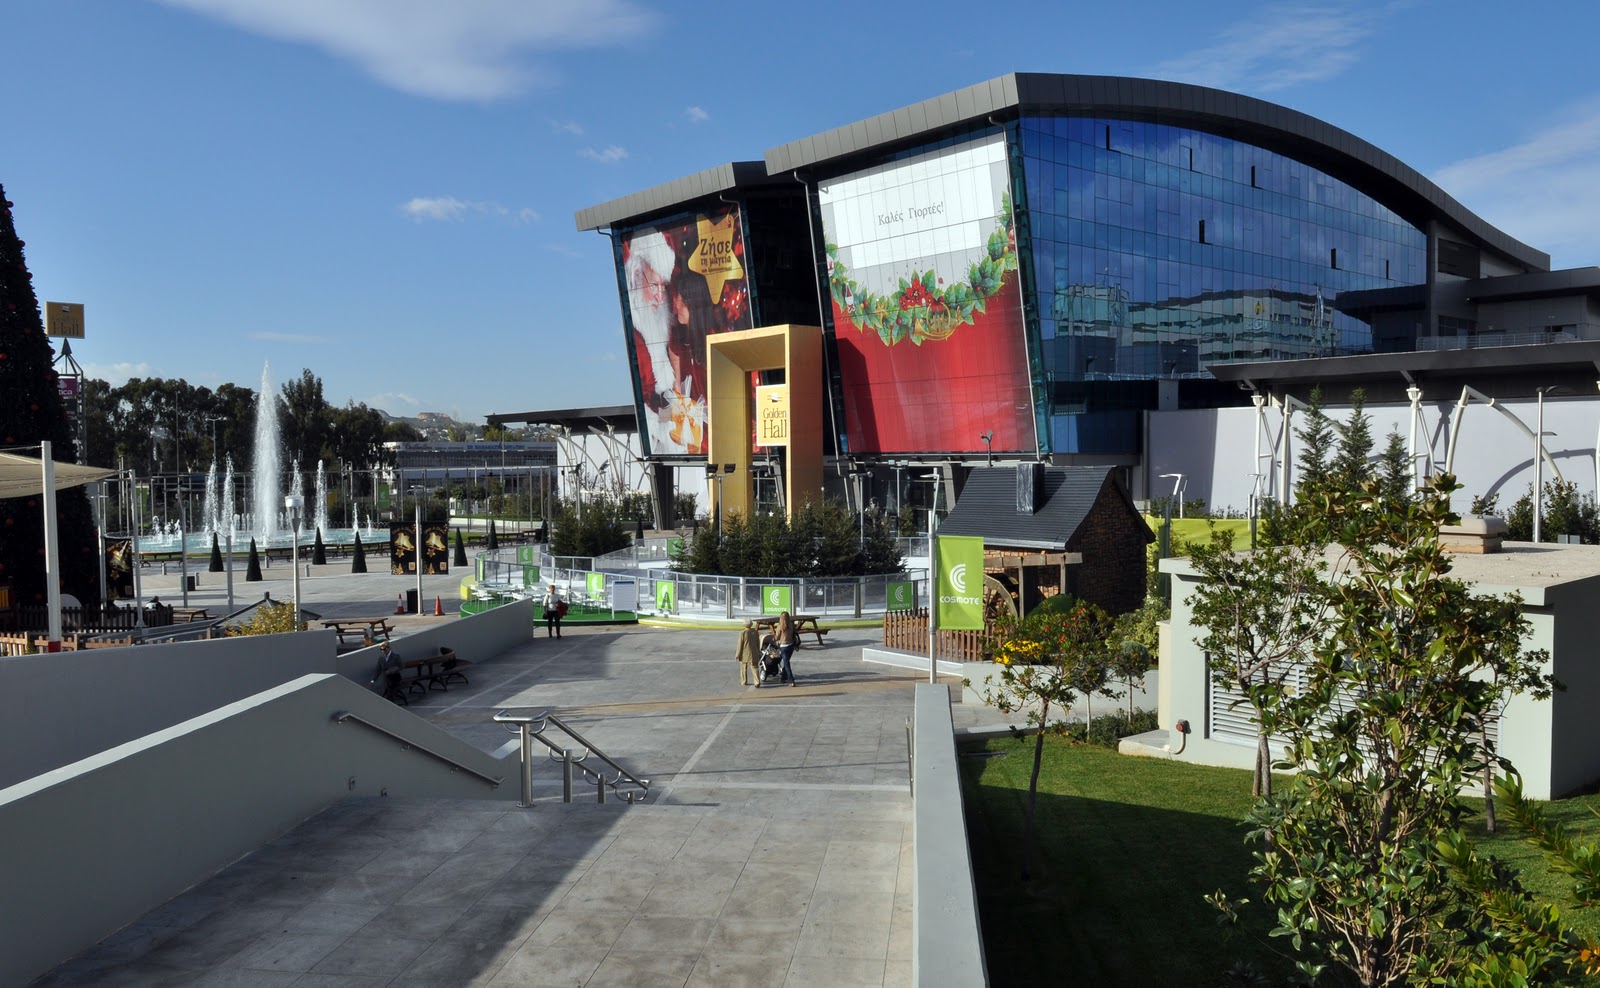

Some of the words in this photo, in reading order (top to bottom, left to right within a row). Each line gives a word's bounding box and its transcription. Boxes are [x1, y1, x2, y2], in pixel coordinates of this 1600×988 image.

[878, 211, 904, 226] Καλές
[908, 201, 944, 219] Γιορτές!
[700, 236, 731, 257] Ζήσε
[701, 258, 708, 267] τη
[763, 408, 787, 419] Golden
[763, 419, 787, 438] Hall
[940, 596, 980, 605] COSMOTE
